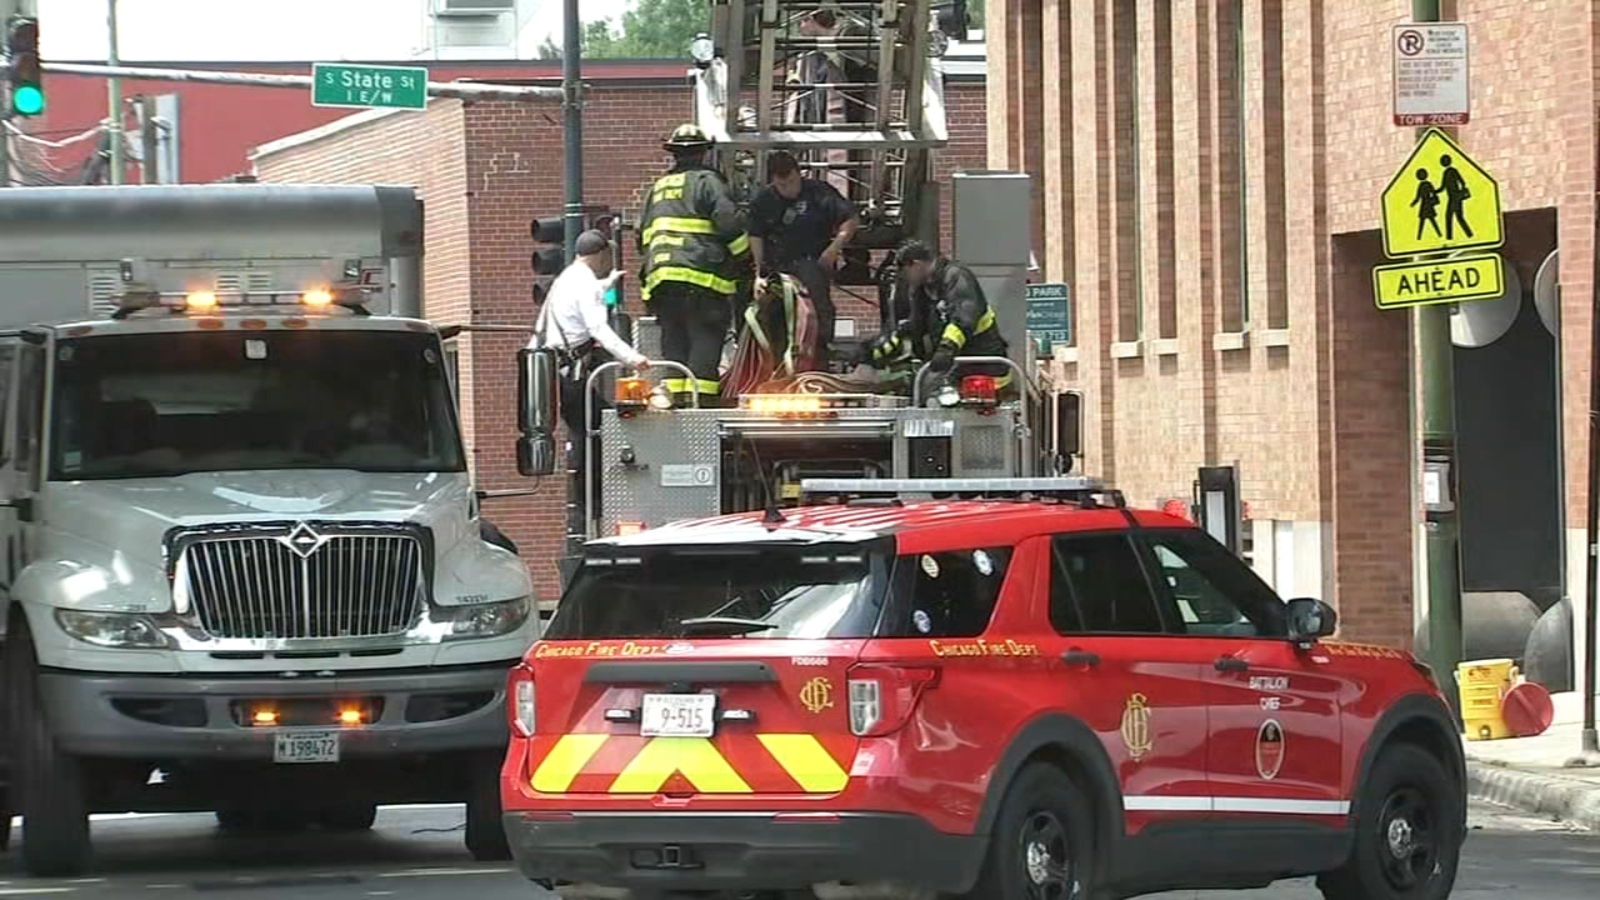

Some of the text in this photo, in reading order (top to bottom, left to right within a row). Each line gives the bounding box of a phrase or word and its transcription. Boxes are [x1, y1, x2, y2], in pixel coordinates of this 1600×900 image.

[325, 70, 414, 90] S State St
[1400, 112, 1463, 125] TOW ZONE
[1397, 267, 1480, 296] AHEAD
[1032, 287, 1062, 298] PARK
[535, 644, 584, 658] CHICAGO
[585, 642, 616, 656] FIRE
[929, 639, 981, 656] CHICAGO
[977, 639, 1008, 656] FIRE
[661, 707, 703, 729] 9-515
